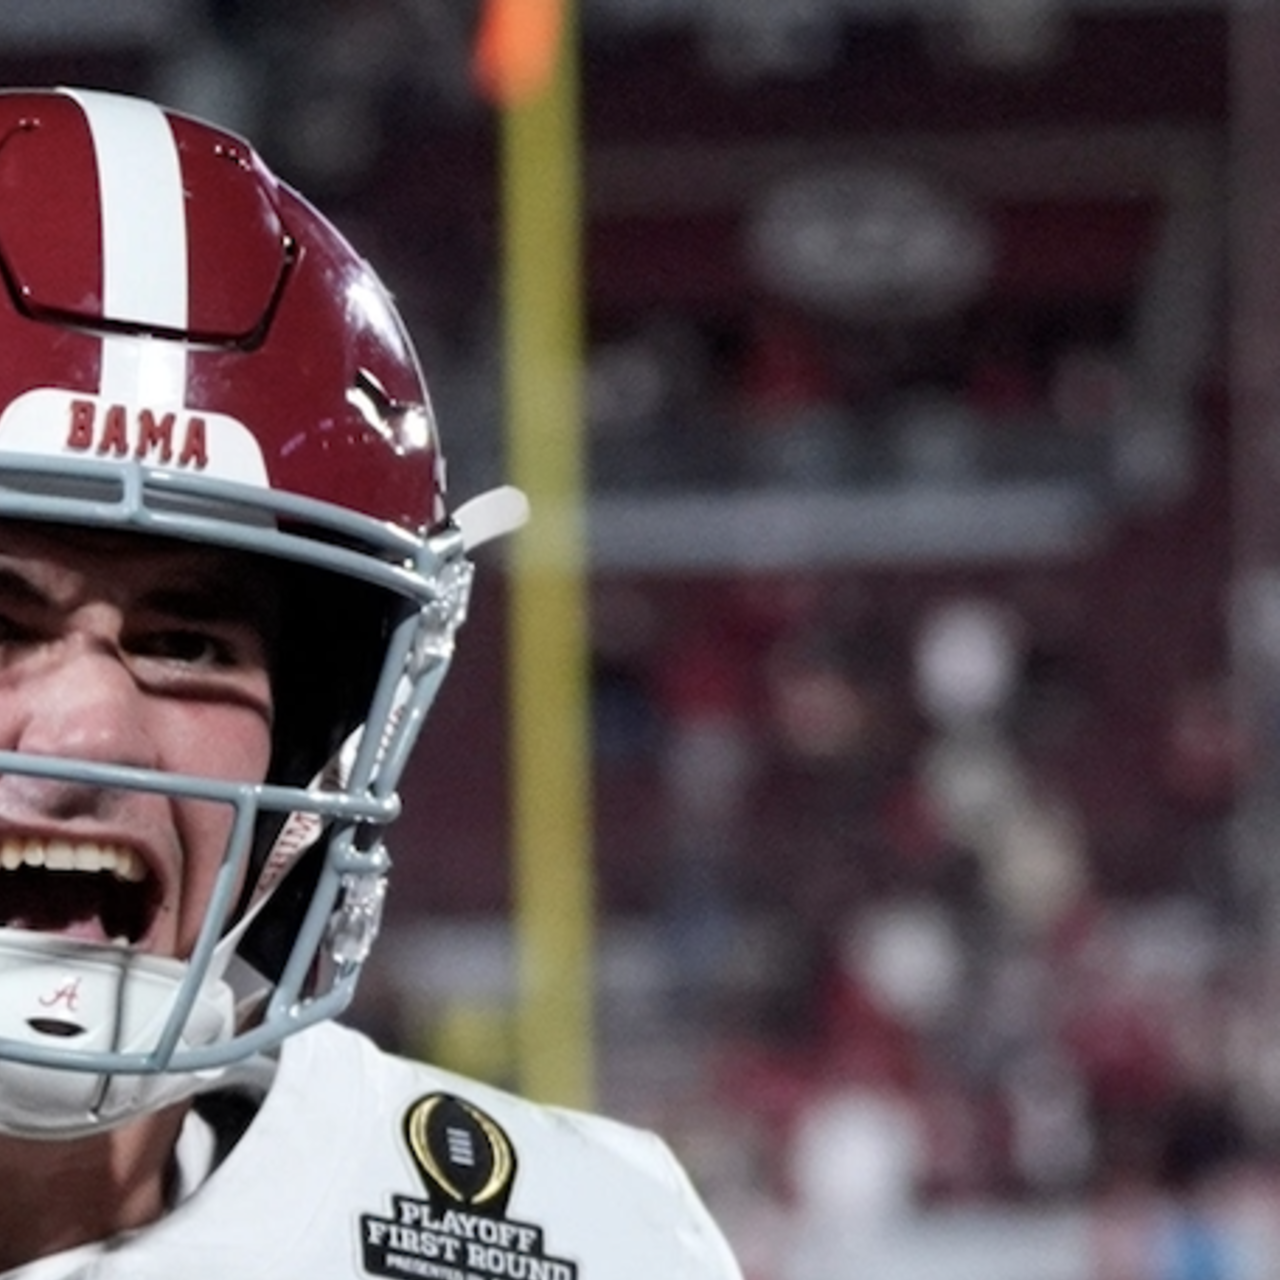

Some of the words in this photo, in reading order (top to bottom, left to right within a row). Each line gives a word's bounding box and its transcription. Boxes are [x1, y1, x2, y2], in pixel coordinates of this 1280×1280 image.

[67, 400, 208, 471] BAMA
[366, 1220, 461, 1262] FIRST
[398, 1201, 537, 1253] PLAYOFF
